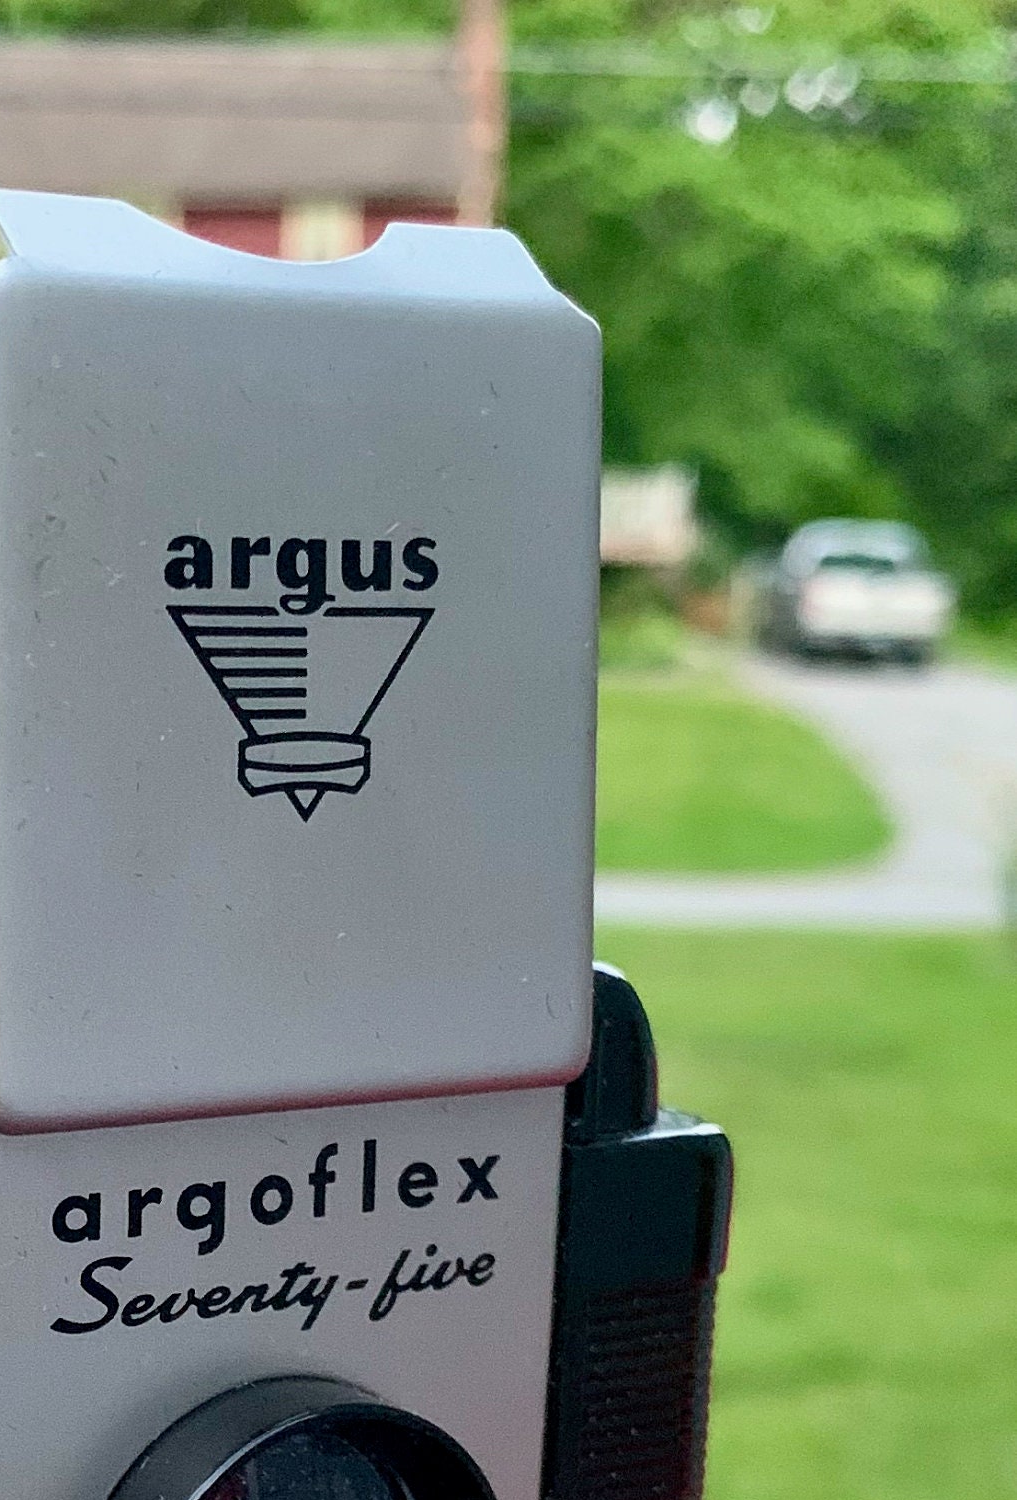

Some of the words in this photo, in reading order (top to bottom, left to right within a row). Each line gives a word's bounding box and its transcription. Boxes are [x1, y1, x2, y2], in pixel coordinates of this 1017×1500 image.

[164, 535, 439, 616] argus
[51, 1138, 501, 1256] argoflex
[49, 1243, 497, 1335] Seventy-five
